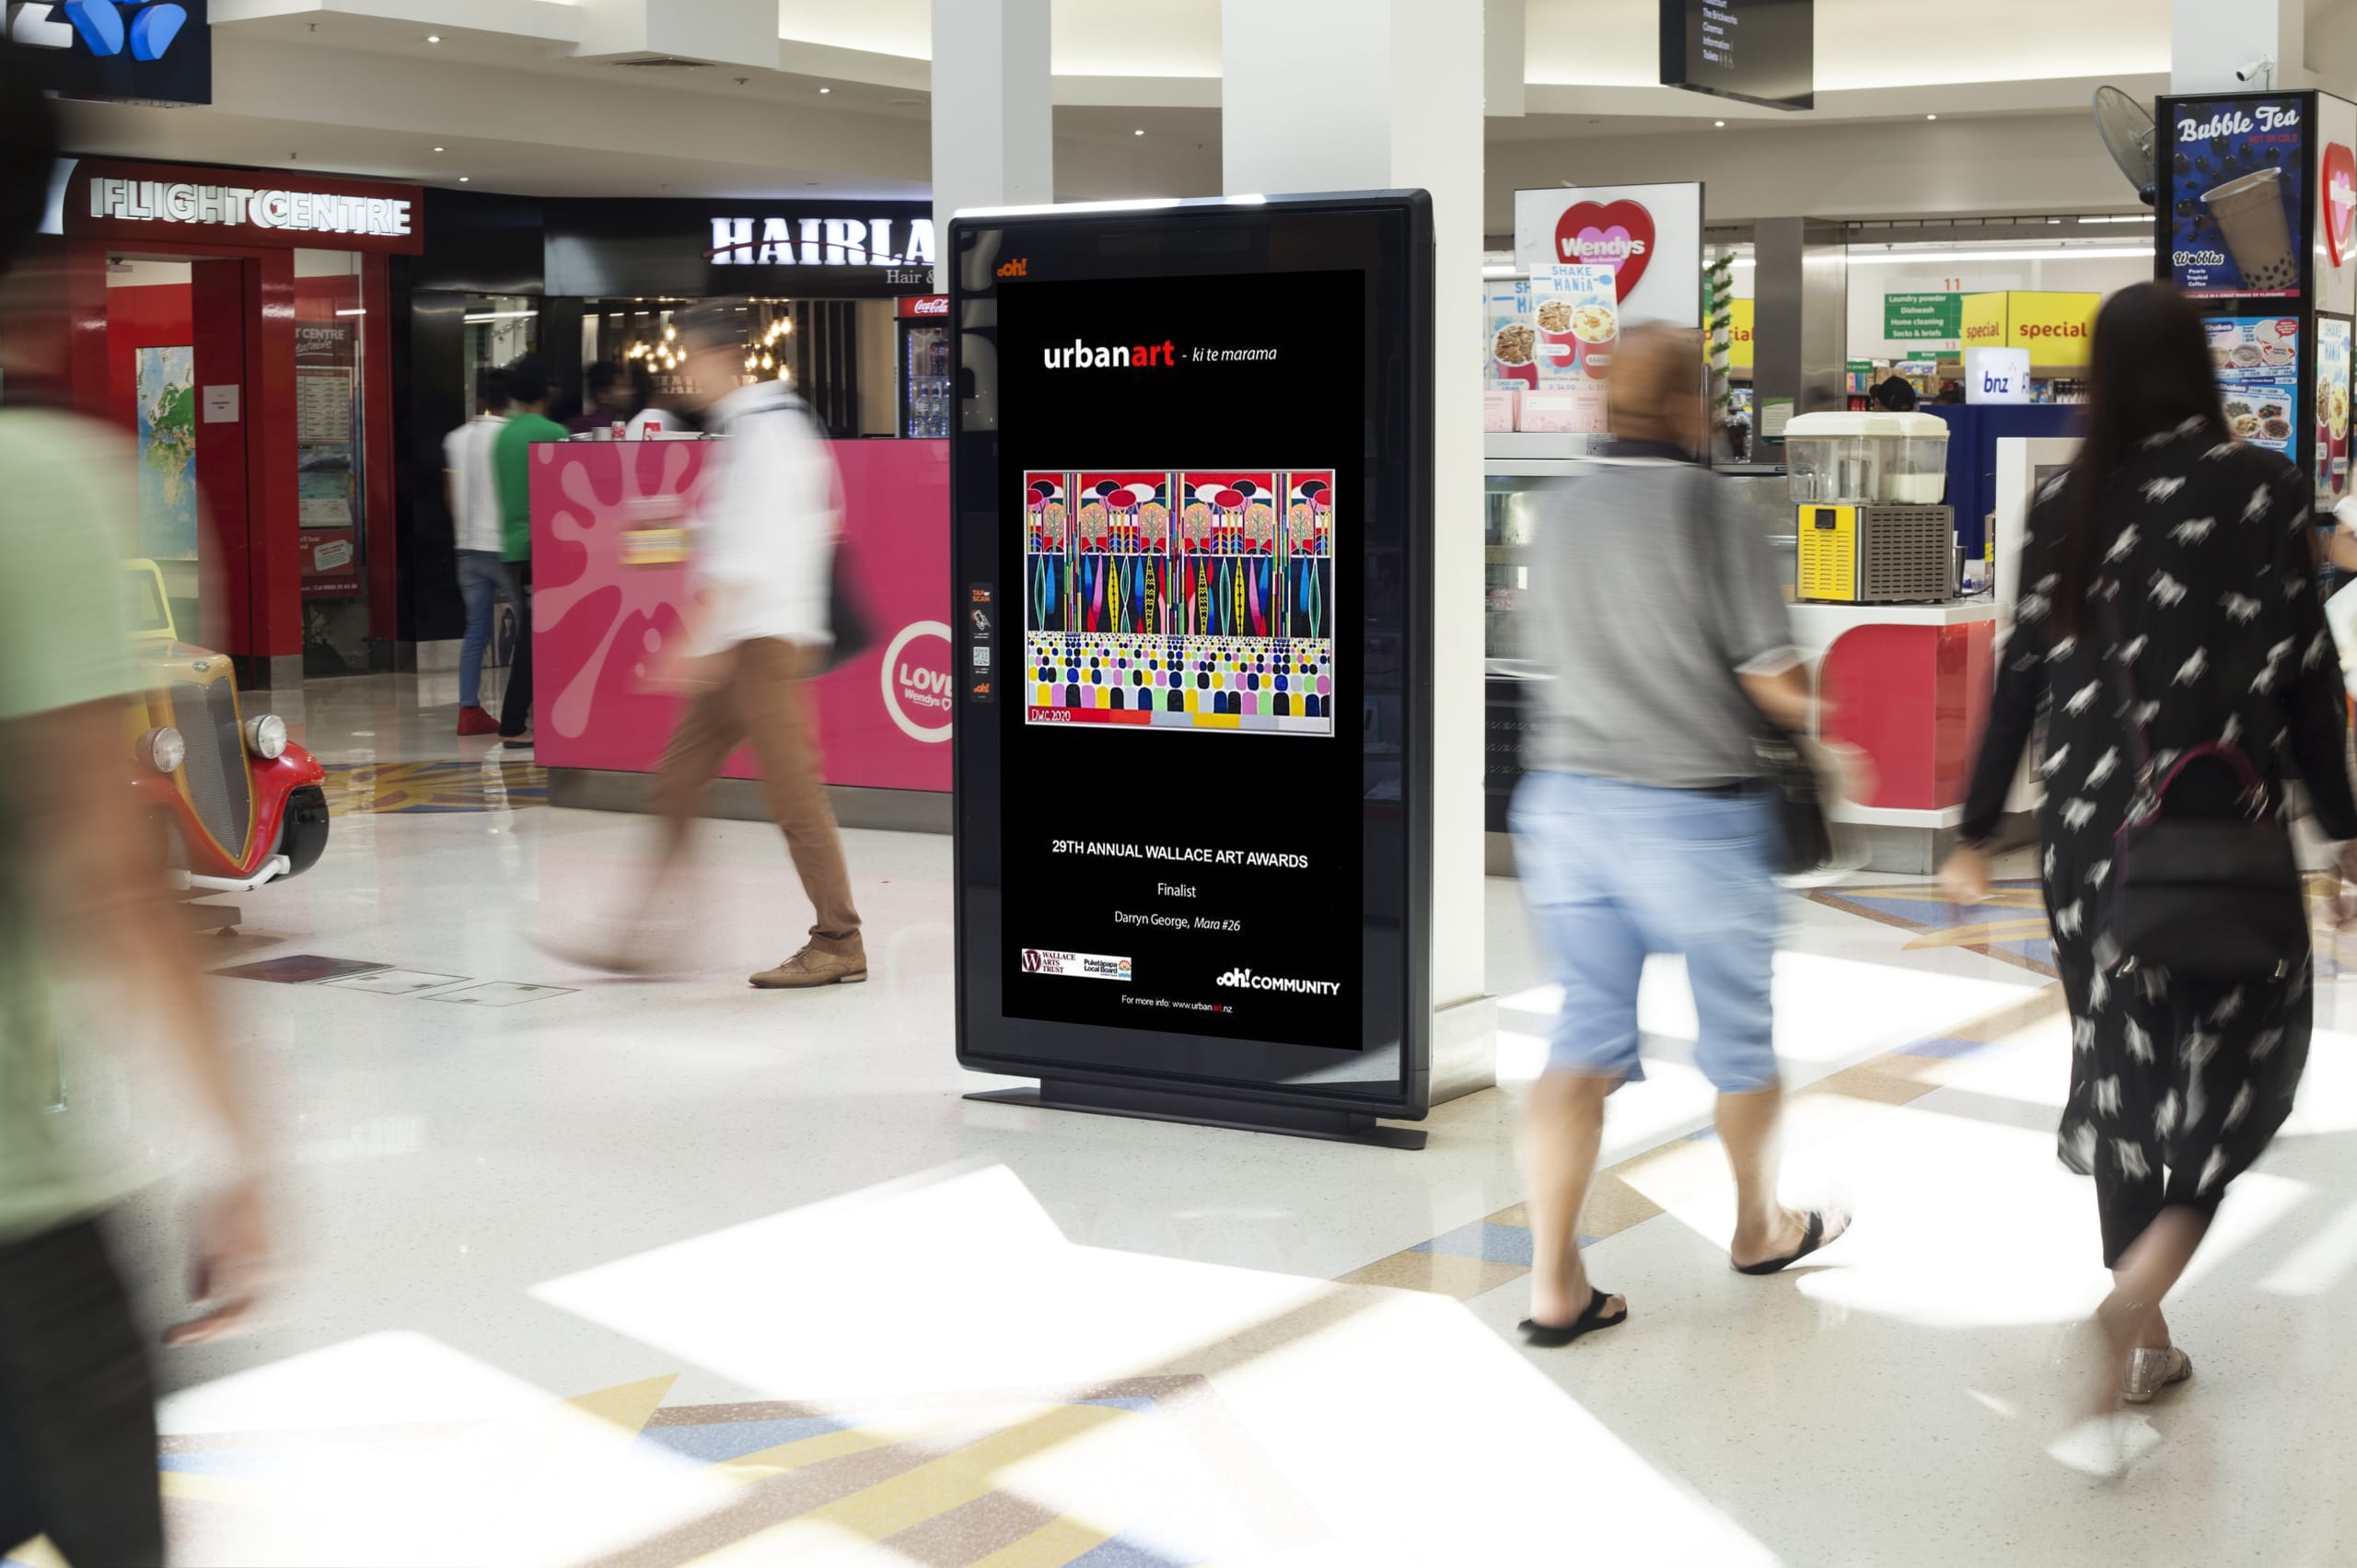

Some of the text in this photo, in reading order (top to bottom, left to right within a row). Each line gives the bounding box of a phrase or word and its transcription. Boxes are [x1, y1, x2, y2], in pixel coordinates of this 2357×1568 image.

[2177, 106, 2300, 142] Bubble Tea
[1562, 236, 1645, 260] Wendys
[886, 269, 922, 284] Hair
[1551, 265, 1592, 276] SHAKE
[1945, 278, 1960, 291] 11
[1888, 295, 1946, 304] Laundry powder
[1913, 318, 1944, 327] cleaning
[2019, 321, 2087, 339] special
[302, 328, 345, 340] CENTRE
[1922, 329, 1942, 337] briefs
[1966, 321, 2000, 342] special
[1044, 339, 1175, 368] urbanart
[1192, 347, 1204, 362] ki
[1206, 347, 1219, 362] te
[1221, 348, 1278, 362] marama
[1983, 371, 2008, 393] bnz
[904, 688, 942, 707] Wendys
[1052, 840, 1308, 868] 29TH ANNUAL WALLACE ART AWARDS
[1157, 882, 1196, 898] Finalist
[1114, 911, 1241, 932] Darryn George, Mara #26
[1042, 951, 1076, 961] WALLACE
[1043, 965, 1064, 973] TRUST
[1251, 975, 1341, 995] COMMUNITY
[1121, 994, 1133, 1004] For
[1135, 997, 1154, 1006] more
[1155, 997, 1171, 1007] info:
